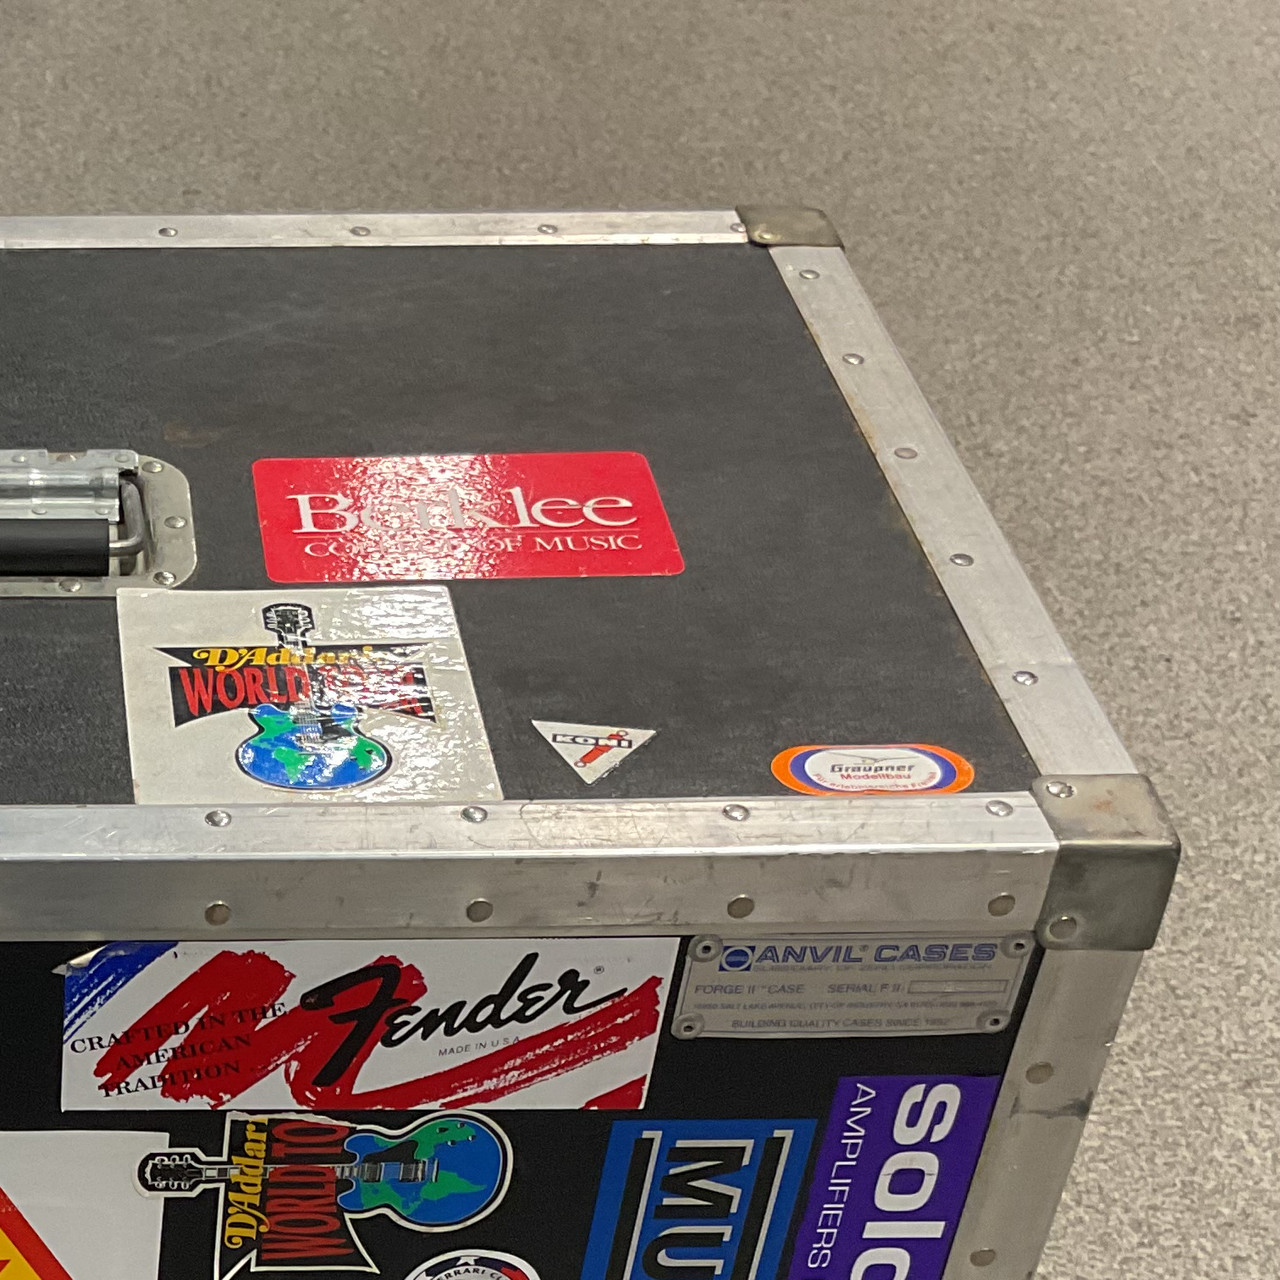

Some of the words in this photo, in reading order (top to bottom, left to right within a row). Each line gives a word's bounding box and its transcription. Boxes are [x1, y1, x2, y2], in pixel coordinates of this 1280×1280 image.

[286, 486, 639, 534] Berklee
[534, 534, 642, 552] MUSIC
[192, 644, 390, 672] D'Addar
[178, 665, 314, 717] WORLD
[830, 763, 915, 774] Graupner
[754, 944, 863, 963] ANVIL
[874, 942, 998, 963] CASES
[694, 983, 744, 995] FORGE
[767, 983, 807, 994] CASE
[827, 982, 874, 994] SERIAL
[70, 1019, 191, 1054] CRAFTED
[197, 1014, 226, 1031] IN
[231, 1002, 288, 1024] THE
[299, 951, 629, 1087] Fender
[842, 1017, 882, 1028] CASES
[116, 1033, 252, 1072] AMERICAN
[438, 1044, 472, 1057] MADE
[475, 1040, 488, 1050] IN
[98, 1060, 241, 1098] TRADITION
[808, 1082, 877, 1269] AMPLIFIERS
[261, 1164, 355, 1260] WORLD
